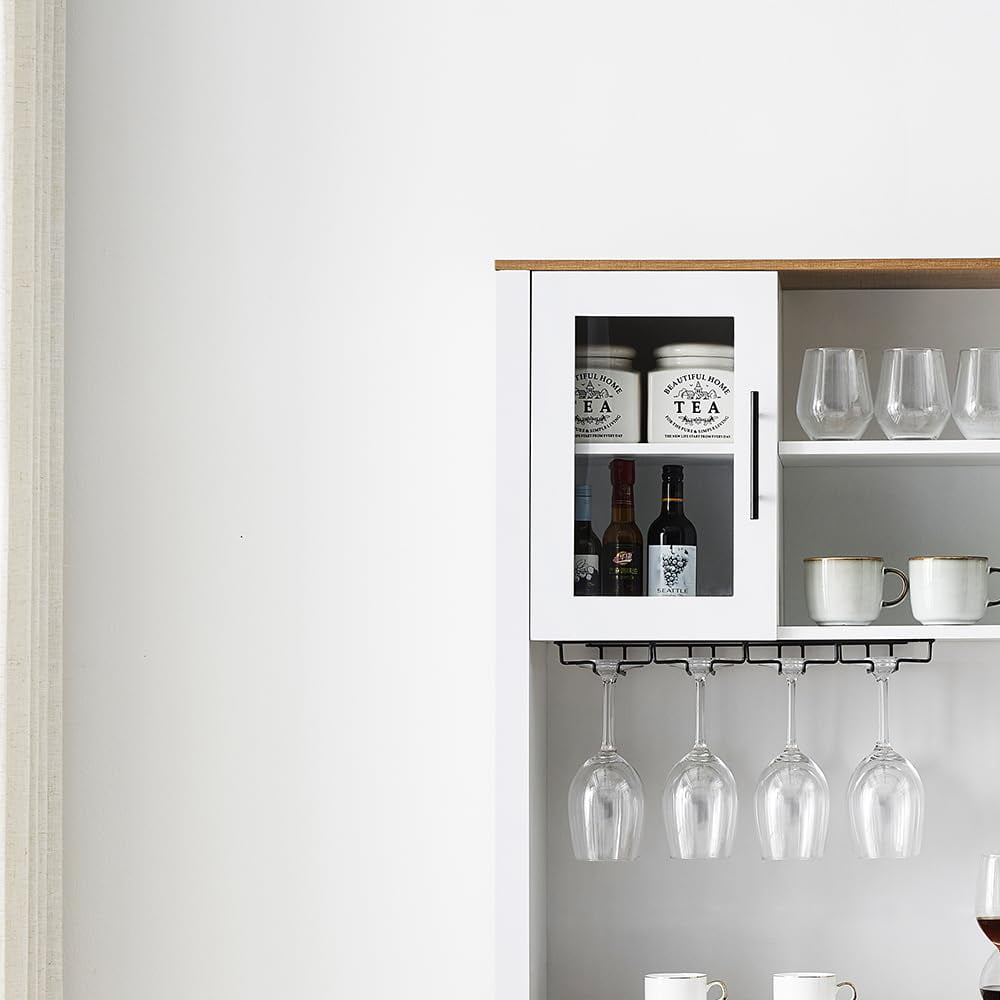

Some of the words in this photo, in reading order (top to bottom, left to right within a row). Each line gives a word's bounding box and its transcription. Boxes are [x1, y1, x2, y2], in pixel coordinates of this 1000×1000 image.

[575, 373, 598, 381] TIFUL
[600, 375, 623, 394] HOME
[664, 373, 706, 395] BEAUTIFUL
[707, 376, 731, 395] HOME
[576, 400, 612, 413] EA
[674, 401, 720, 414] TEA
